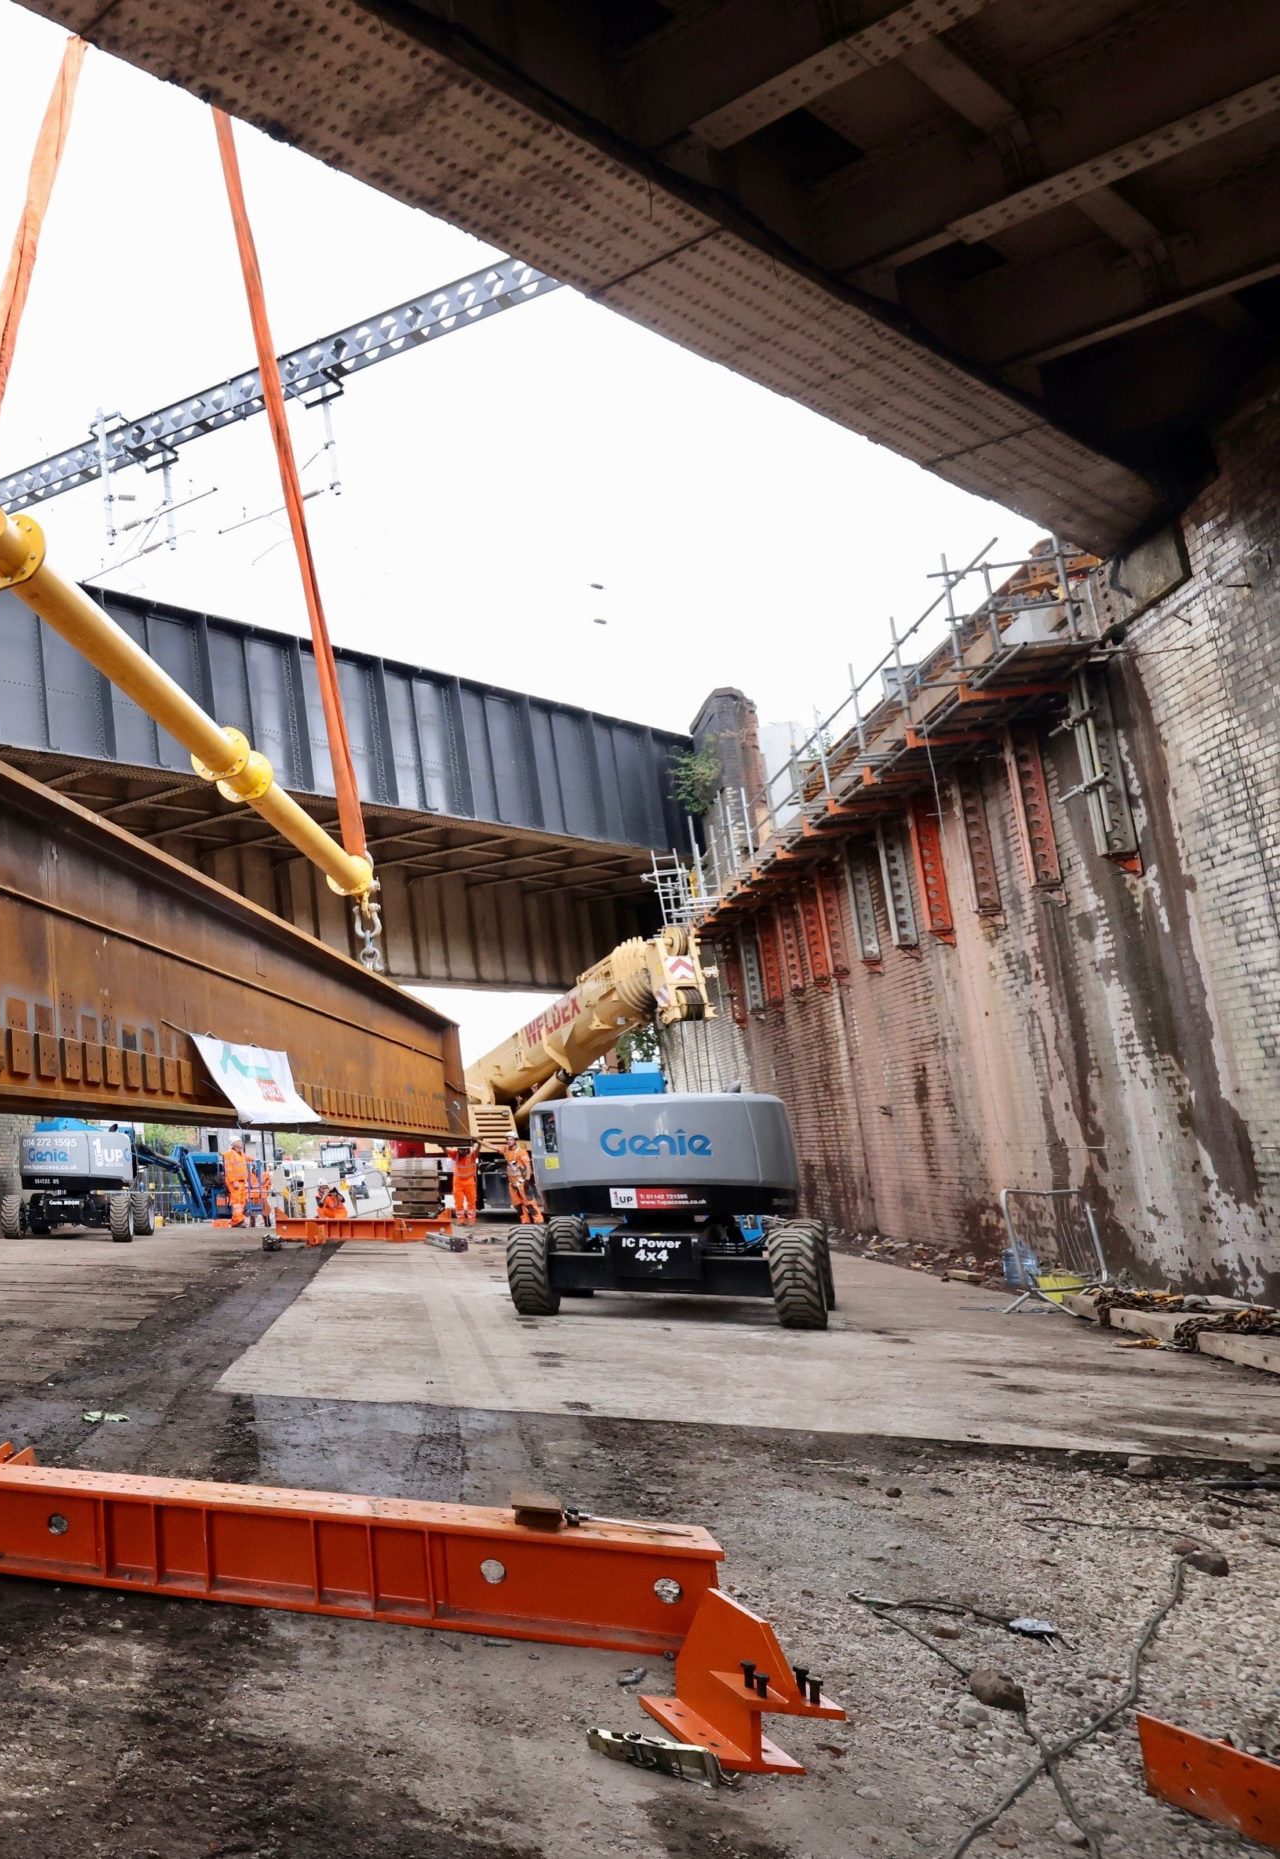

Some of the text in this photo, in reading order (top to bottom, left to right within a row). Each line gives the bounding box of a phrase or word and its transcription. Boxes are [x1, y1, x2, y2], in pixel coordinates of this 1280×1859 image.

[524, 996, 581, 1048] WELDEX
[23, 1138, 77, 1147] 0114 272 1595
[600, 1128, 713, 1157] Genie
[28, 1147, 68, 1162] Genie
[103, 1148, 123, 1163] UP
[619, 1196, 633, 1204] UP
[621, 1238, 681, 1249] IC Power
[634, 1249, 669, 1262] 4x4
